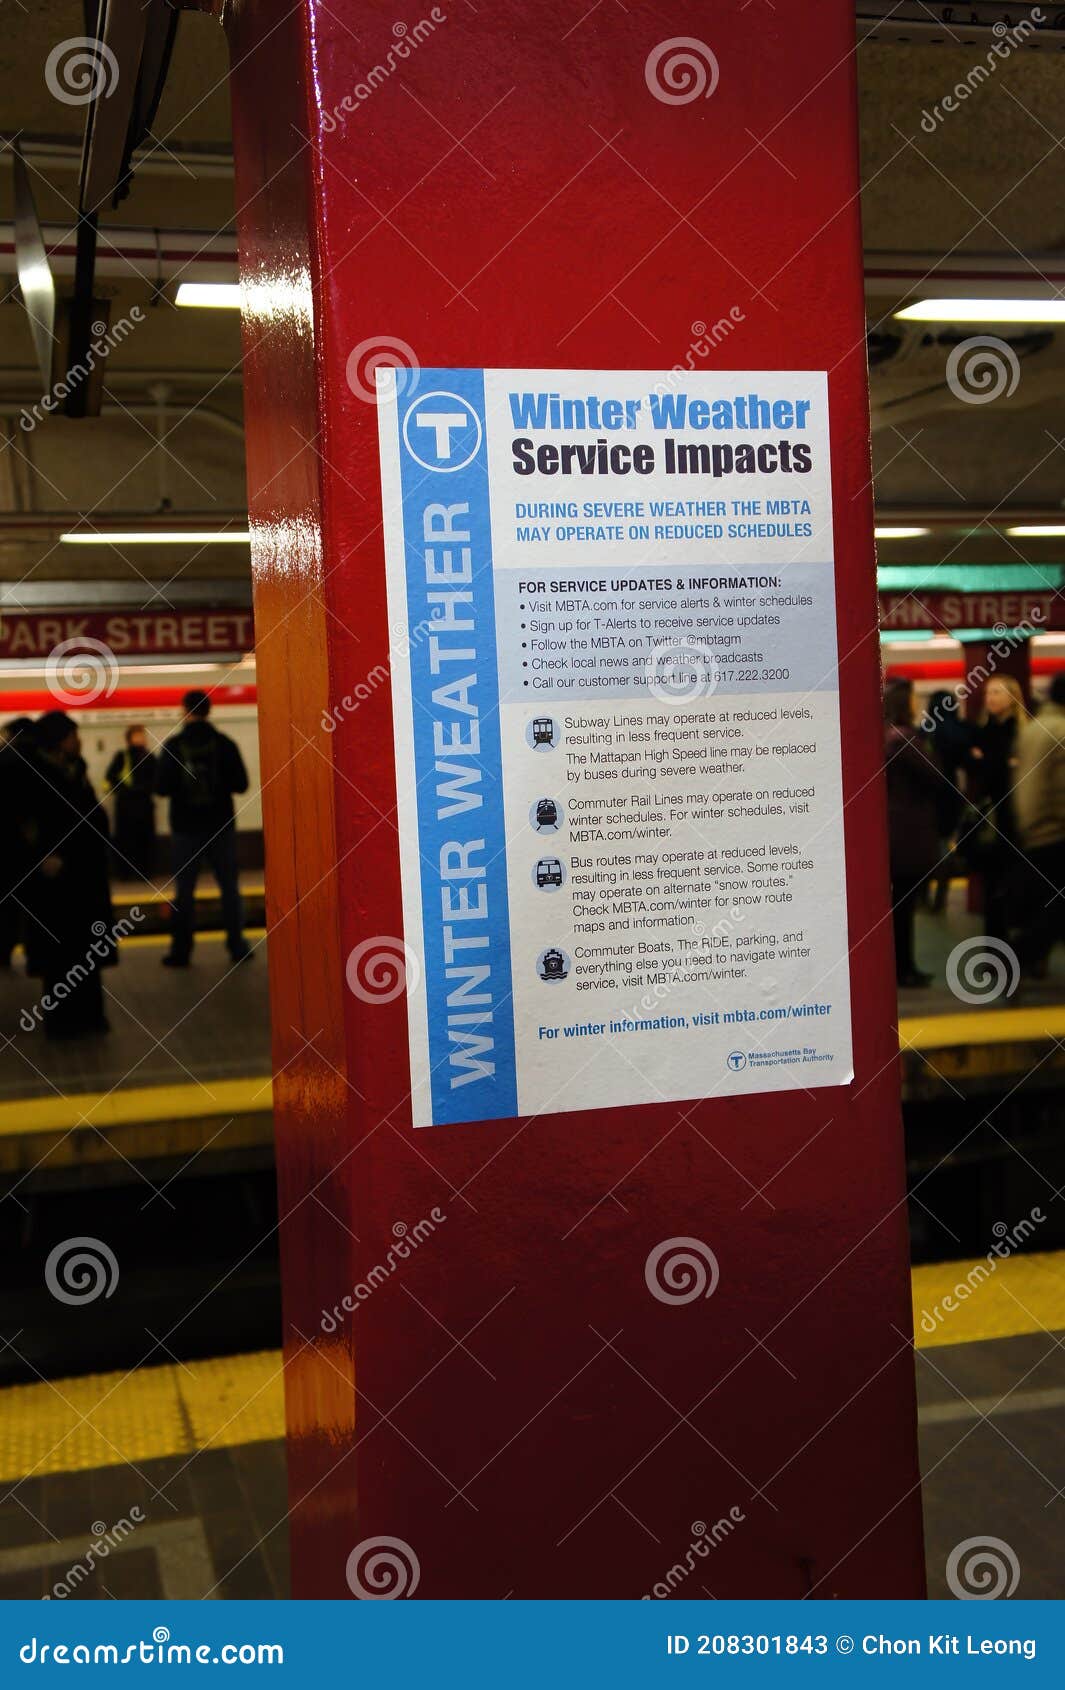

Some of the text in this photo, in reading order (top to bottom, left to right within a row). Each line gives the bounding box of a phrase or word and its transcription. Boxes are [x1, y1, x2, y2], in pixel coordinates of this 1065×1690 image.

[509, 393, 811, 430] Winter Weather
[512, 437, 812, 477] Service Impacts
[515, 500, 811, 518] DURING SEVERE WEATHER THE MBTA
[516, 522, 812, 541] MAY OPERATE ON REDUCED SCHEDULES
[519, 576, 781, 593] FOR SERVICE UPDATES & INFORMATION:
[529, 593, 813, 612] Visit MBTA.com for service alerts & winter schedules
[943, 596, 1051, 625] STREET
[105, 614, 250, 649] STREET
[530, 613, 781, 634] Sign up for T-Alerts to receive service updates
[531, 632, 742, 650] Follow the MBTA on Twitter @mbtagm
[532, 651, 764, 669] Check local news and weather broadcasts
[532, 668, 790, 688] Call our customer support line at 617.222.3200
[565, 707, 814, 730] Subway Lines may operate at reduced levels,
[565, 726, 745, 747] resulting in less frequent service.
[566, 742, 817, 765] The Mattapan High Speed line may be replaced
[567, 761, 745, 783] by buses during severe weather.
[423, 502, 496, 1089] WINTER WEATHER
[568, 785, 816, 810] Commuter Rail Lines may operate on reduced
[569, 802, 810, 826] winter schedules. For winter schedules, visit
[570, 825, 672, 842] MBTA.com/winter.
[571, 843, 802, 868] Bus routes may operate at reduced levels,
[571, 858, 815, 886] resulting in less frequent service. Some routes
[572, 889, 596, 903] may
[598, 885, 643, 901] operate
[645, 886, 660, 895] on
[663, 880, 711, 894] alternate
[573, 891, 793, 916] Check MBTA.com/winter for snow route
[576, 976, 618, 992] service,
[621, 974, 643, 987] visit
[538, 1001, 832, 1039] For winter information, visit mbta.com/winter
